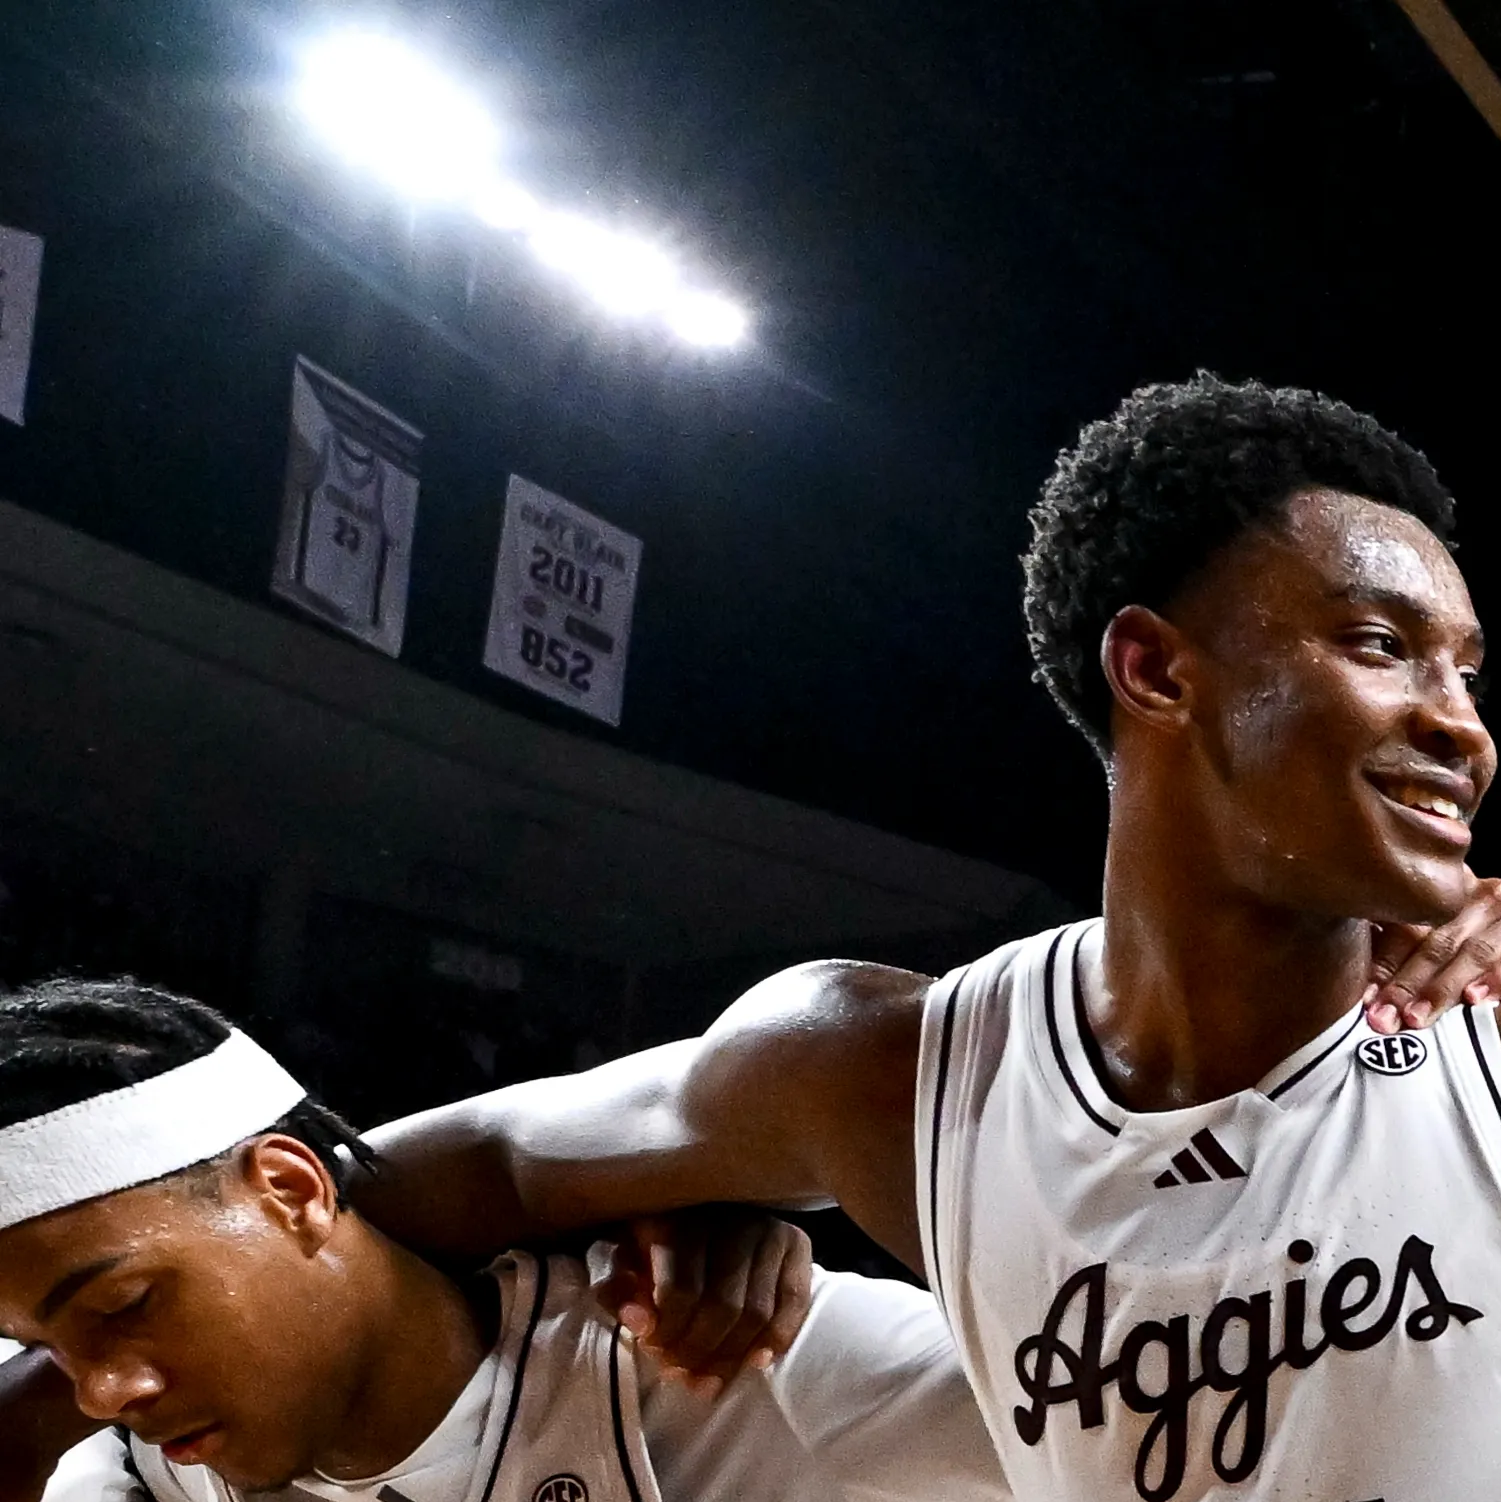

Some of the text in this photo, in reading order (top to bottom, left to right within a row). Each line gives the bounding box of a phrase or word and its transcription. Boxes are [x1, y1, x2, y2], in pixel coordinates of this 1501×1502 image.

[529, 546, 603, 613] 2011
[520, 624, 594, 692] 852
[1363, 1036, 1420, 1069] SEC
